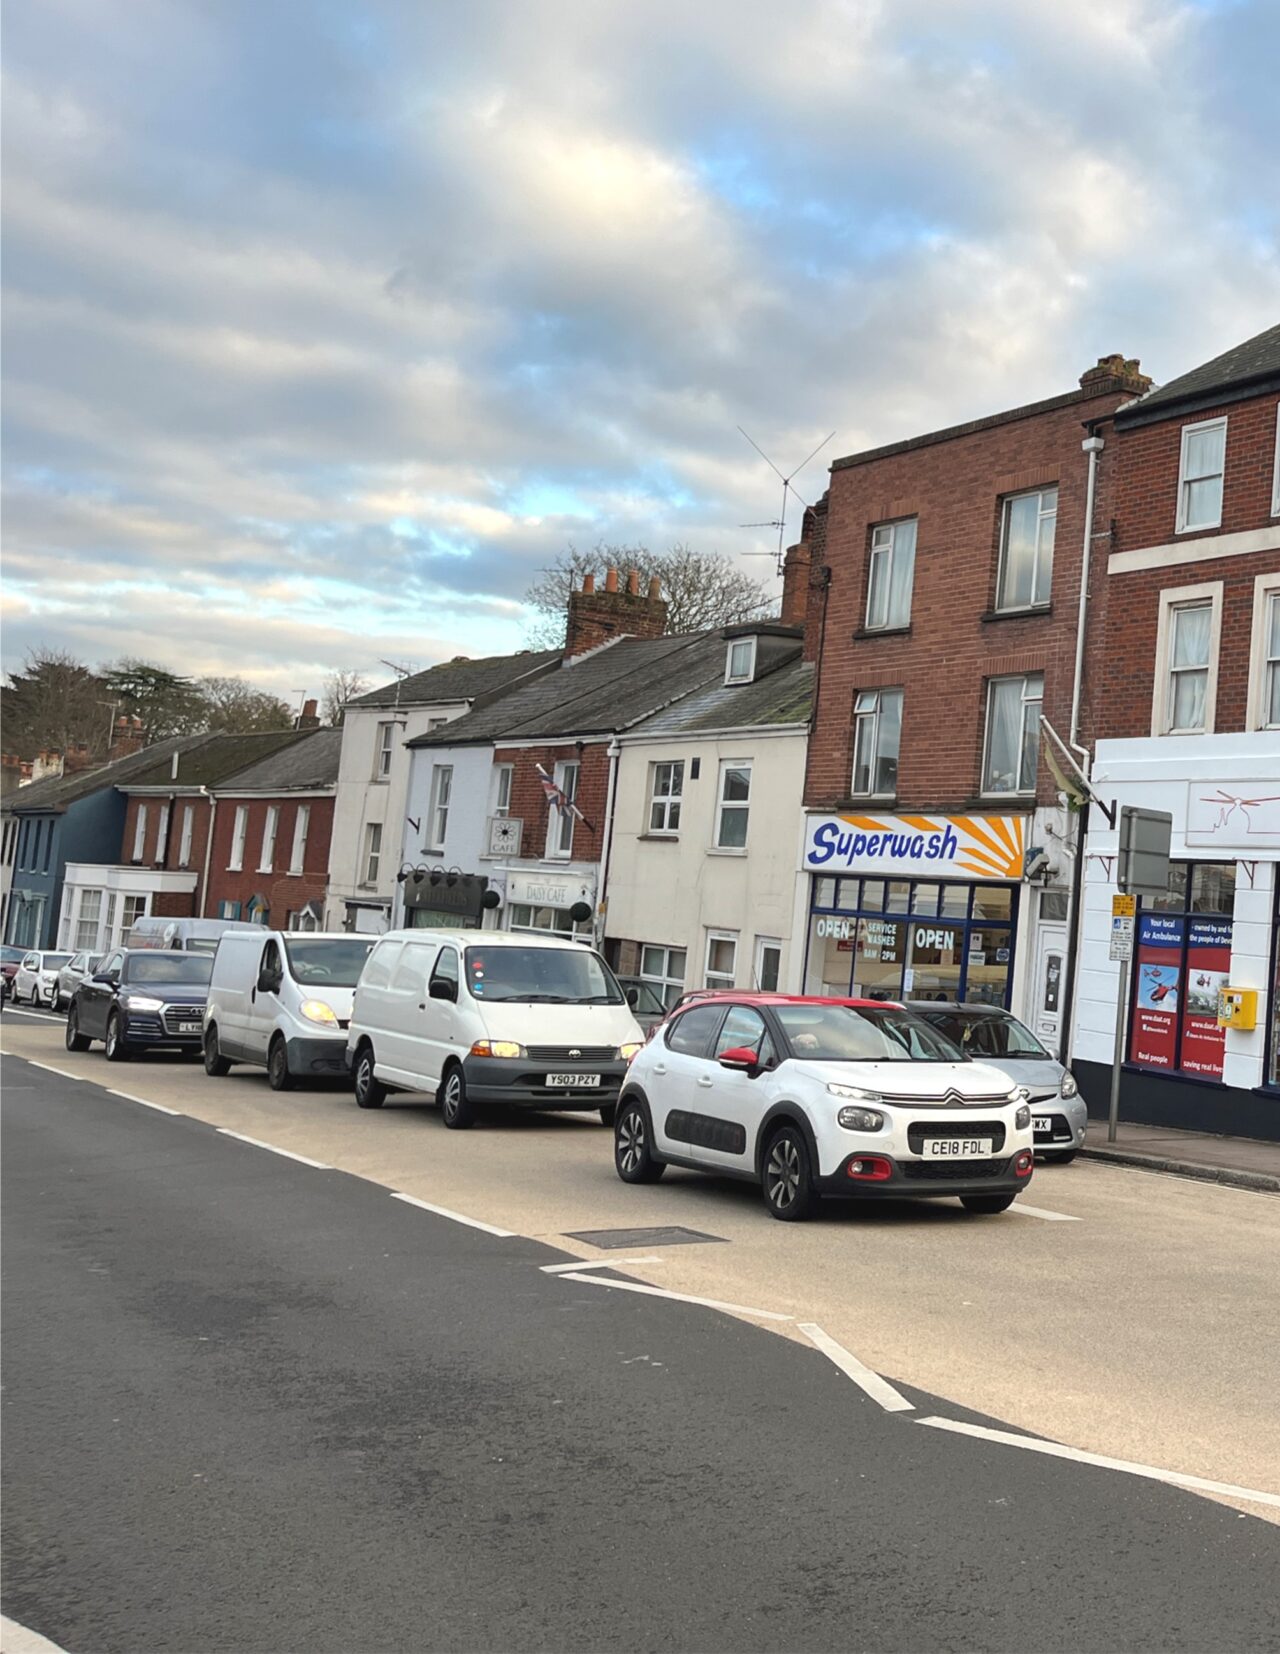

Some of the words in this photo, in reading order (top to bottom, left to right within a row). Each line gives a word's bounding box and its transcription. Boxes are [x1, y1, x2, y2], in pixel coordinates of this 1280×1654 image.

[491, 843, 516, 854] CAFE
[807, 822, 958, 867] Superwash
[526, 885, 548, 901] DAISY
[549, 887, 567, 903] CAFE
[816, 919, 850, 940] OPEN
[867, 922, 897, 935] SERVICE
[1162, 919, 1175, 928] local
[1194, 924, 1210, 933] owned
[1211, 924, 1217, 934] by
[1217, 925, 1227, 933] and
[867, 934, 896, 947] WASHES
[915, 928, 954, 950] OPEN
[1142, 930, 1151, 939] Air
[1151, 931, 1182, 942] Ambulance
[1189, 934, 1197, 942] the
[1198, 935, 1214, 945] people
[1215, 935, 1221, 944] of
[1138, 1051, 1150, 1061] Real
[1150, 1054, 1168, 1065] people
[1183, 1060, 1200, 1071] saving
[1201, 1062, 1212, 1071] real
[551, 1075, 576, 1085] YS03
[577, 1075, 597, 1085] PZY
[932, 1141, 959, 1155] CE18
[962, 1140, 985, 1154] FDL
